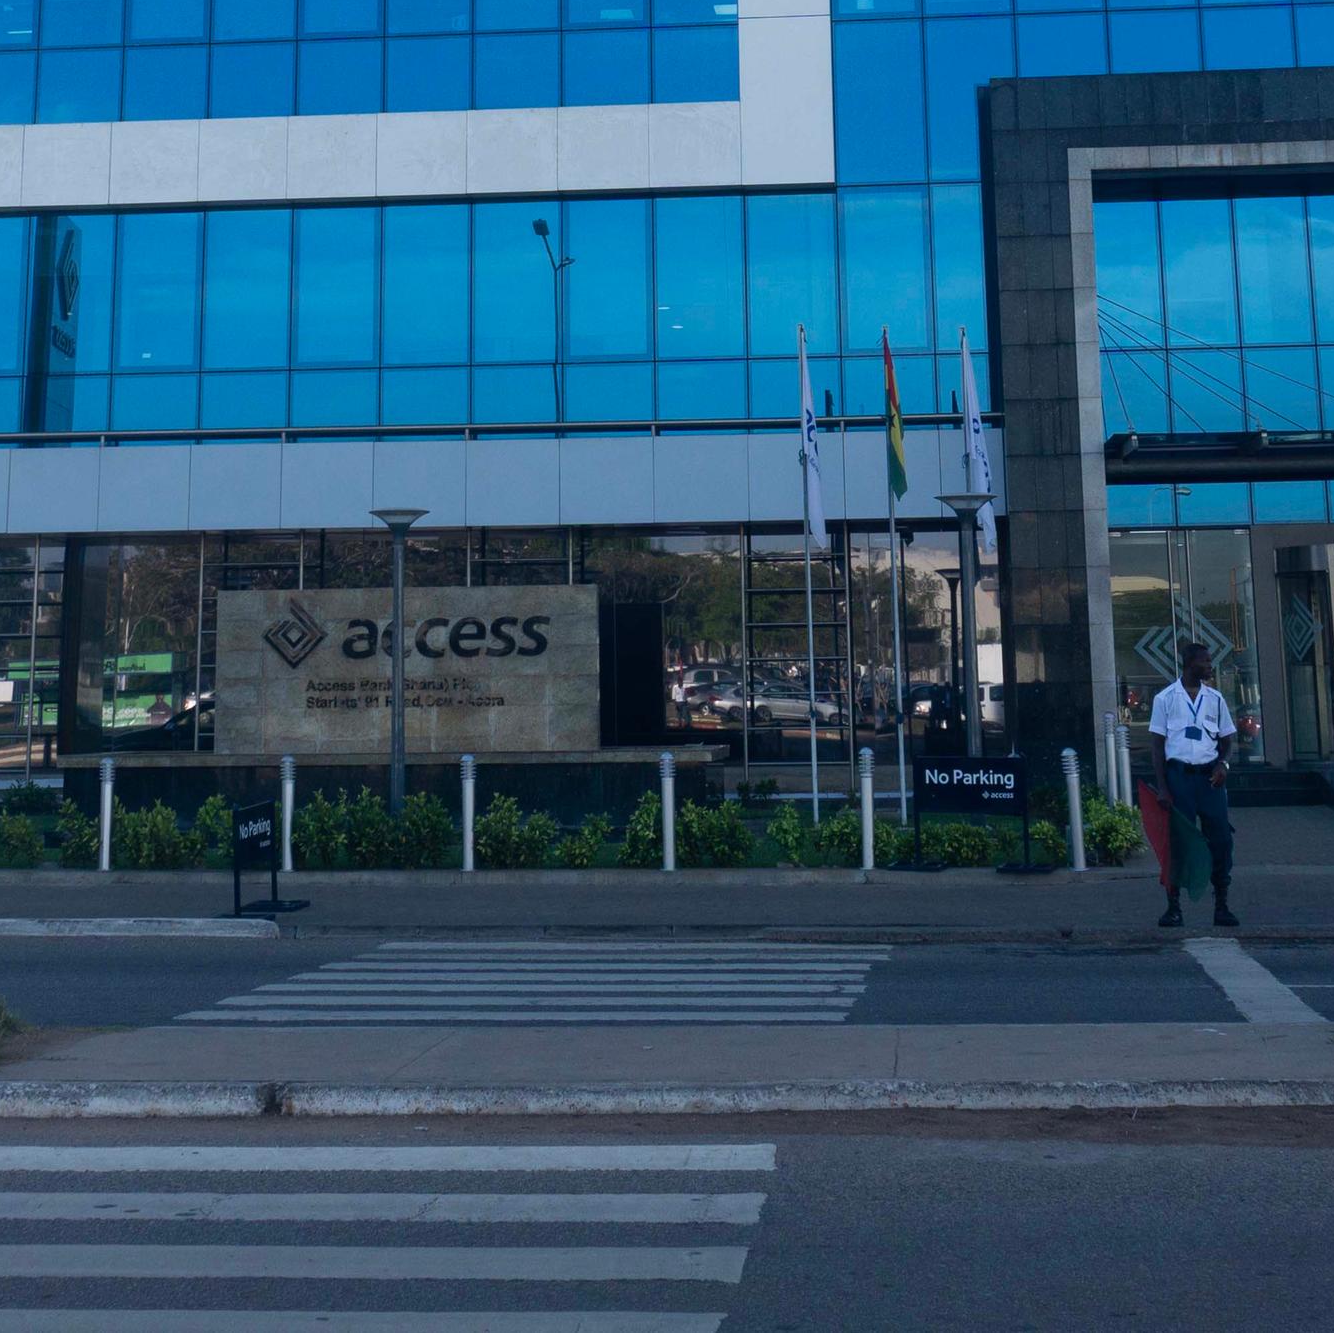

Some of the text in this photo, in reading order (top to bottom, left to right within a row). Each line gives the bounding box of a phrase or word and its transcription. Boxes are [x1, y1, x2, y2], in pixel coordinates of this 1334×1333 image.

[342, 616, 551, 659] access
[306, 679, 355, 692] Access
[306, 695, 361, 709] Starlts'
[925, 769, 1014, 789] No Parking
[239, 817, 271, 840] No Parking
